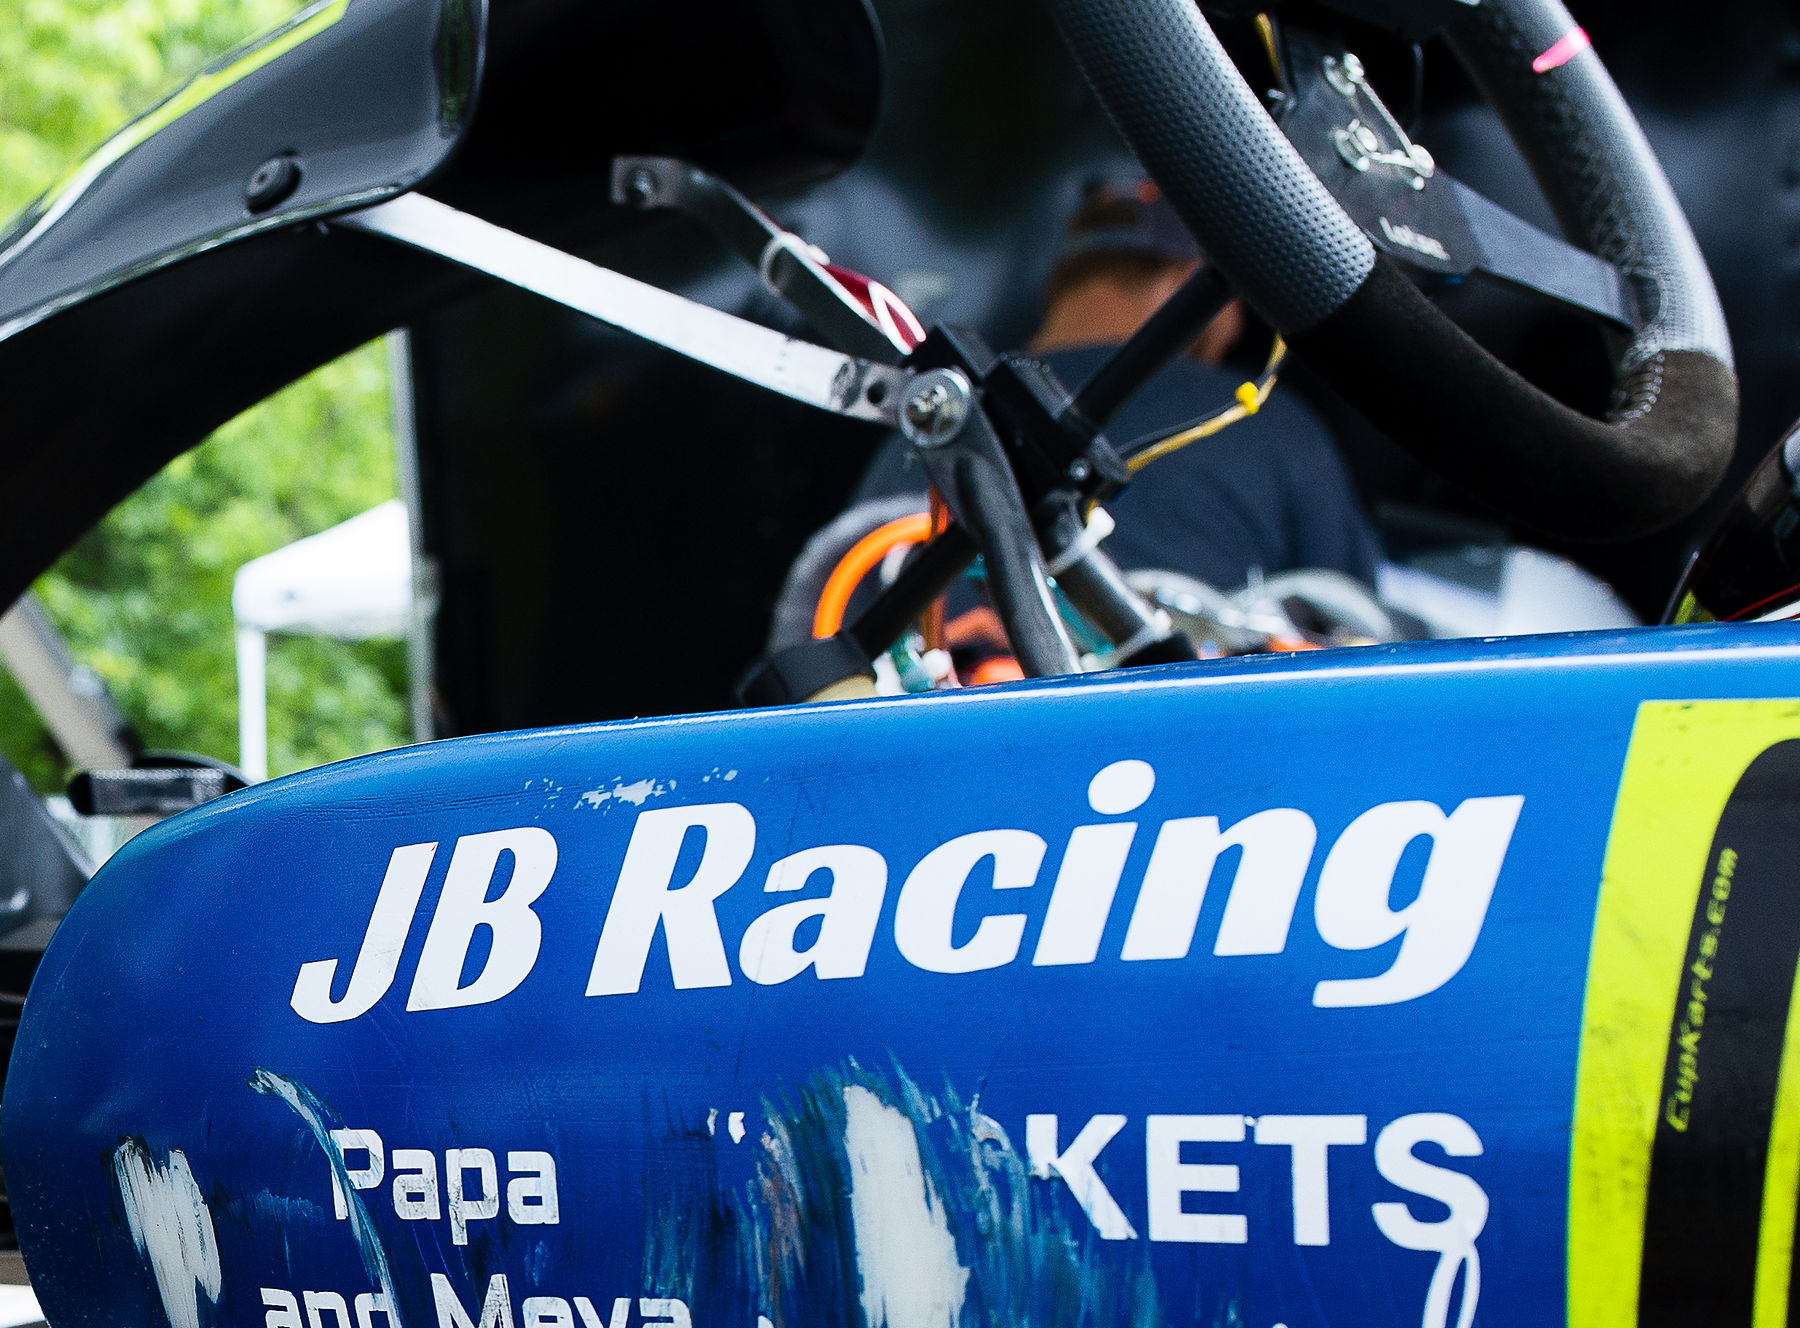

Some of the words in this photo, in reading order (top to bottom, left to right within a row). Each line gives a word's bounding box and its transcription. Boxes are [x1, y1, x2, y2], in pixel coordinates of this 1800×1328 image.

[289, 826, 559, 1024] JB
[584, 756, 1526, 1008] Racing
[329, 1126, 561, 1246] Papa
[1025, 1112, 1491, 1254] KETS
